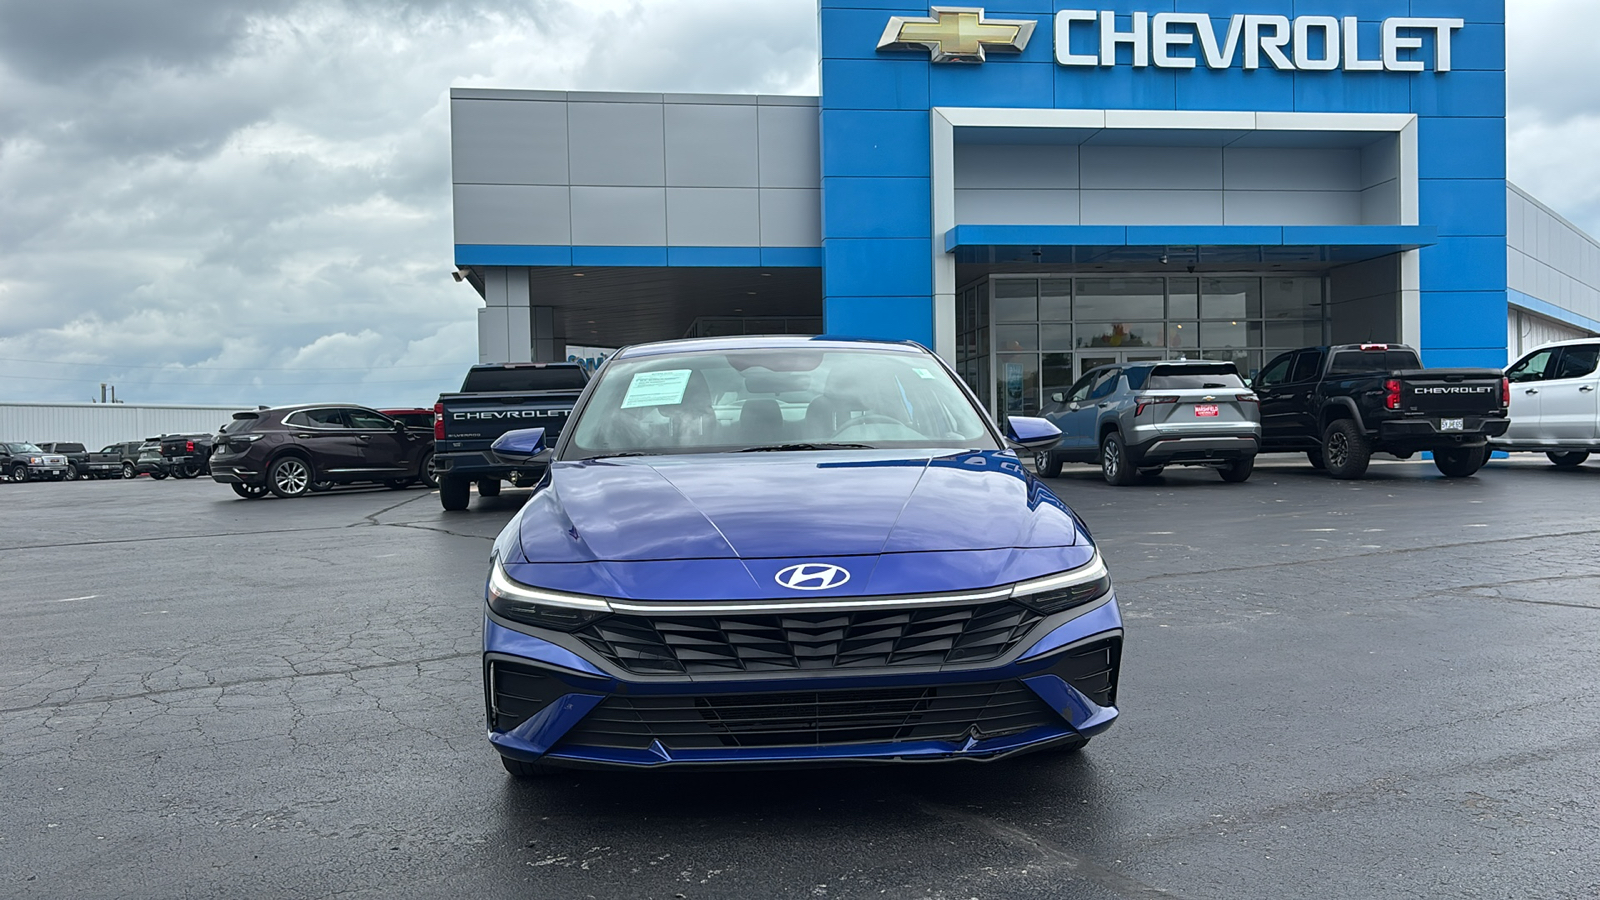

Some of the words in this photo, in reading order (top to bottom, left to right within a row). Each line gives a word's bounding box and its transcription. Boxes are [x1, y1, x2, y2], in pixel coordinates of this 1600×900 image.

[1054, 9, 1465, 72] CHEVROLET
[1414, 386, 1494, 394] CHEVROLET
[453, 409, 572, 420] CHEVROLET
